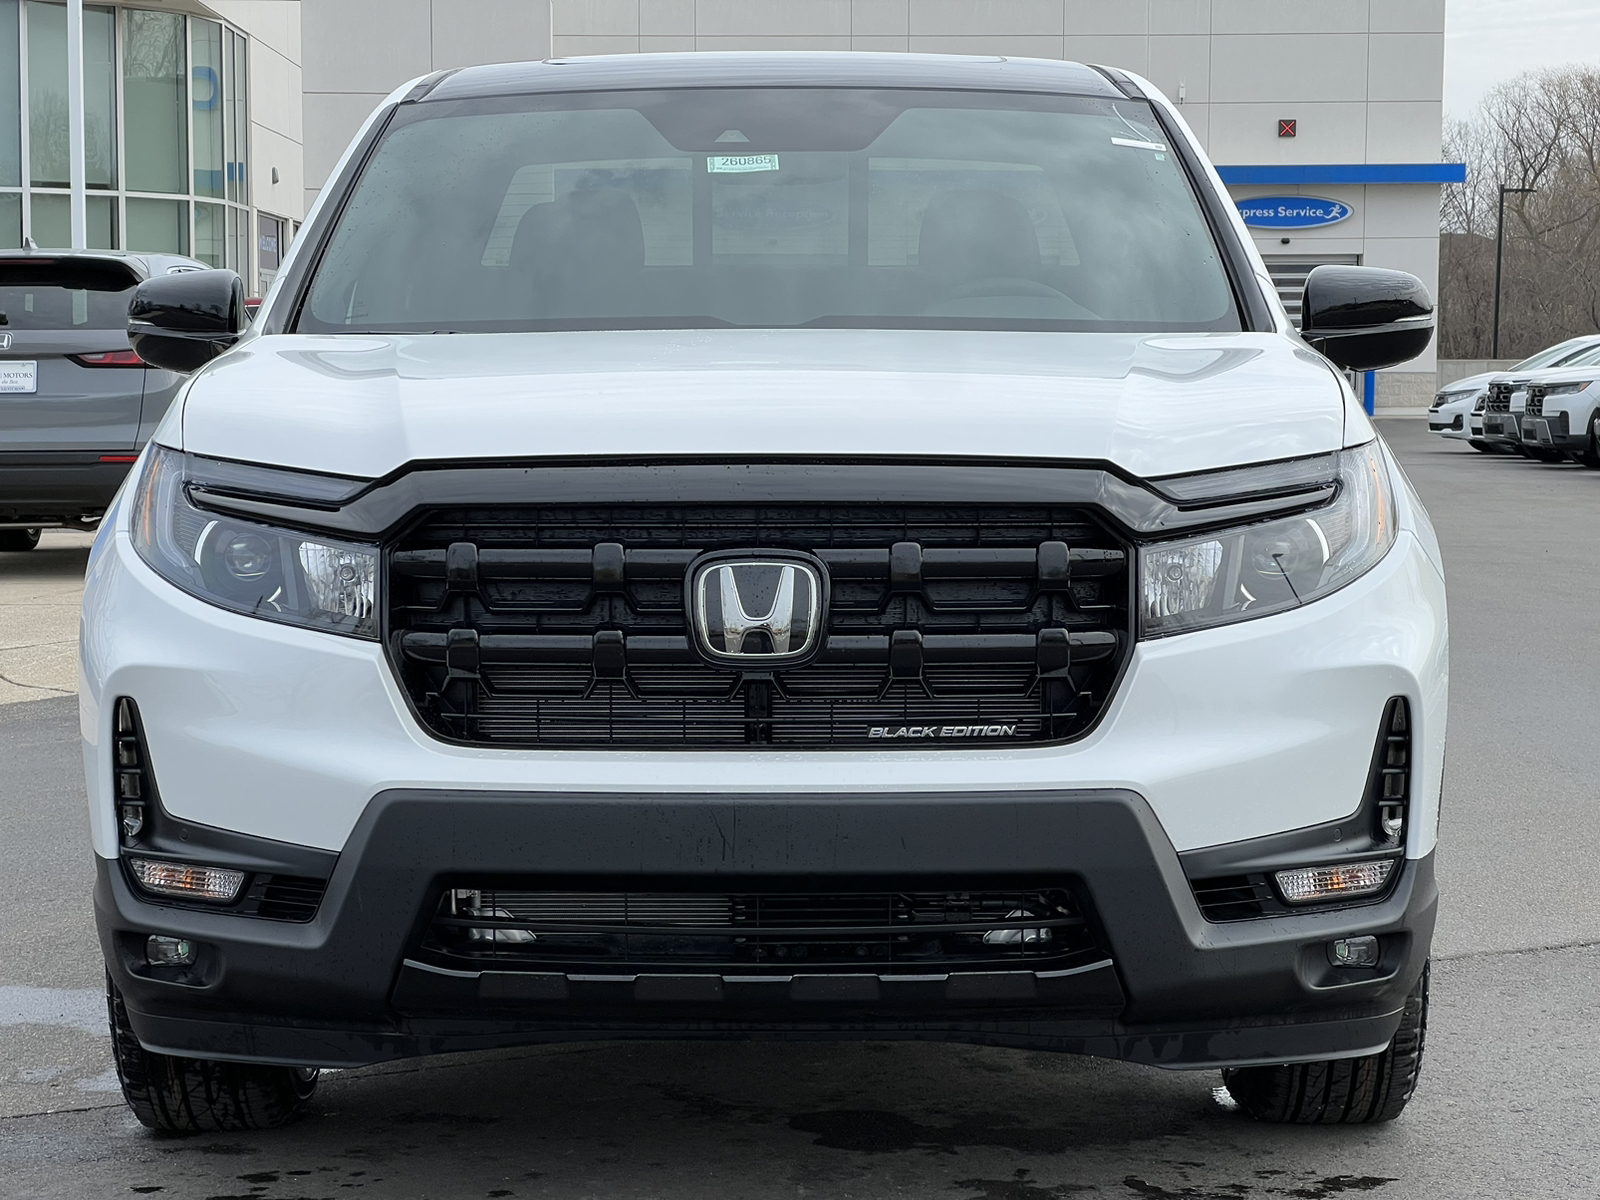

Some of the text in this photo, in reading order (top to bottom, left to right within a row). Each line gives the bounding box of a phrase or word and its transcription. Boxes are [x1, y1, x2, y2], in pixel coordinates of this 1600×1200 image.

[721, 156, 772, 166] 260865
[1277, 206, 1324, 217] Service
[868, 725, 1016, 738] BLACK EDITION
